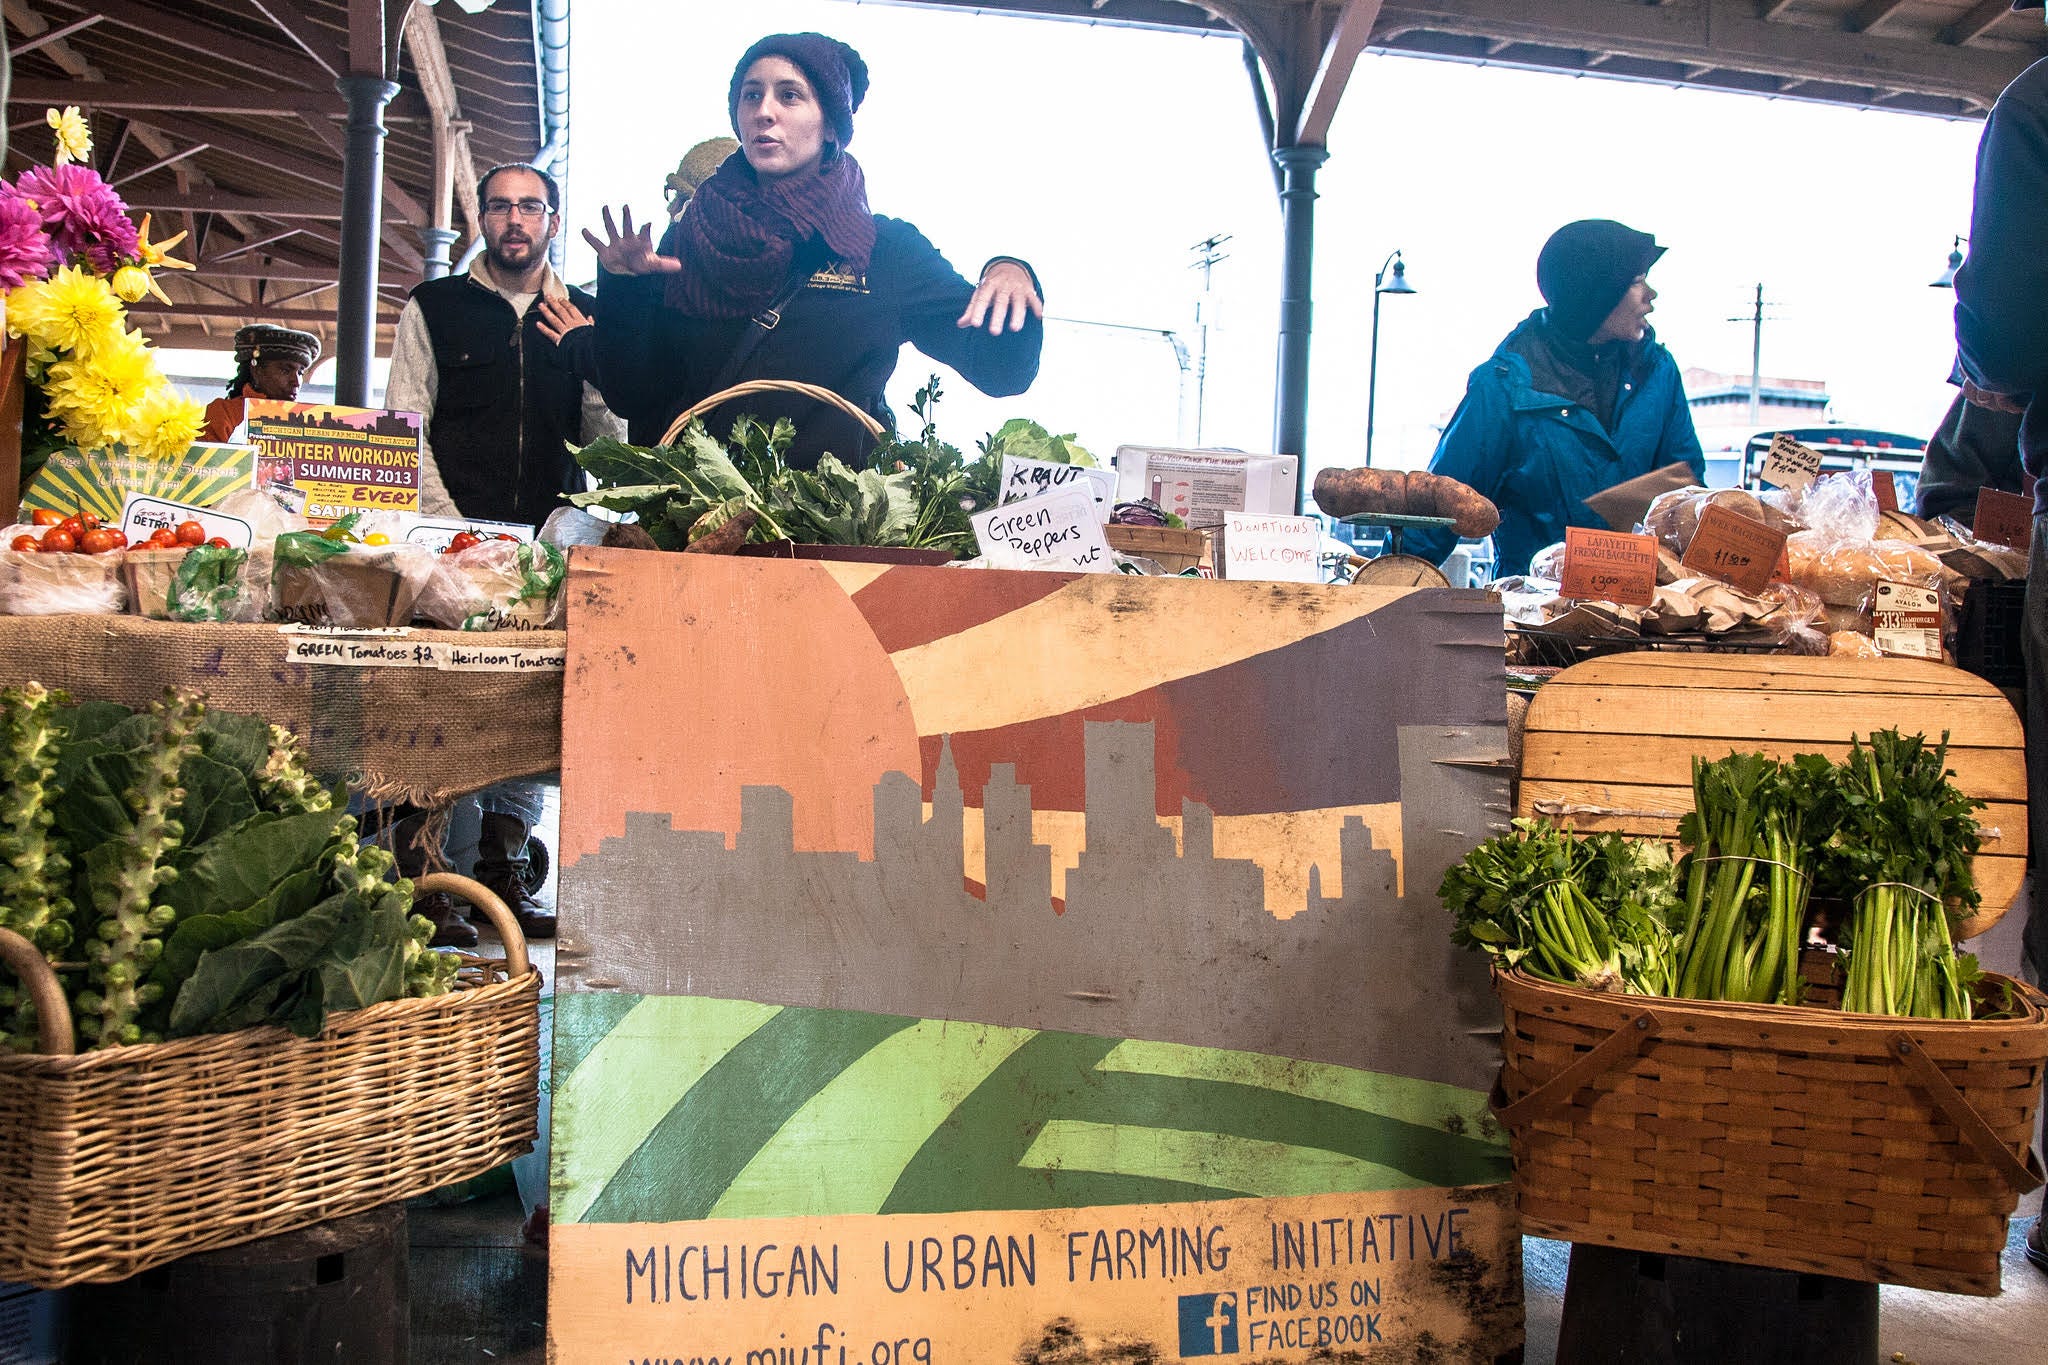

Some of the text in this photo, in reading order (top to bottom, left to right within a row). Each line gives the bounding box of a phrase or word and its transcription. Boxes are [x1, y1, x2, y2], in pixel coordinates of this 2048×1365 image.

[263, 426, 417, 446] MICHIGAN URBAN FARMING INITIATIVE
[49, 453, 82, 469] Yoga
[247, 438, 419, 468] VOLUNTEER WORKDAYS
[97, 472, 181, 489] Urban Farm
[300, 463, 412, 485] SUMMER 2013
[1010, 464, 1085, 487] KRAUT
[351, 486, 418, 505] EVERY
[134, 515, 181, 531] DETRO
[987, 508, 1051, 541] Green
[1233, 520, 1308, 534] DONATIONS
[1008, 525, 1081, 557] Peppers
[1587, 536, 1639, 552] LAFAYETTE
[1574, 546, 1650, 564] FRENCH BAGUETTE
[1895, 600, 1922, 608] AVALON
[296, 642, 434, 664] GREEN Tomatoes $2
[451, 650, 565, 669] Heirloom Tomatoes
[626, 1208, 1470, 1304] MICHIGAN URBAN FARMING INITIATIVE
[1246, 1277, 1381, 1317] FIND US ON
[629, 1322, 932, 1365] miufi.org
[1249, 1312, 1382, 1354] FACEBOOK
